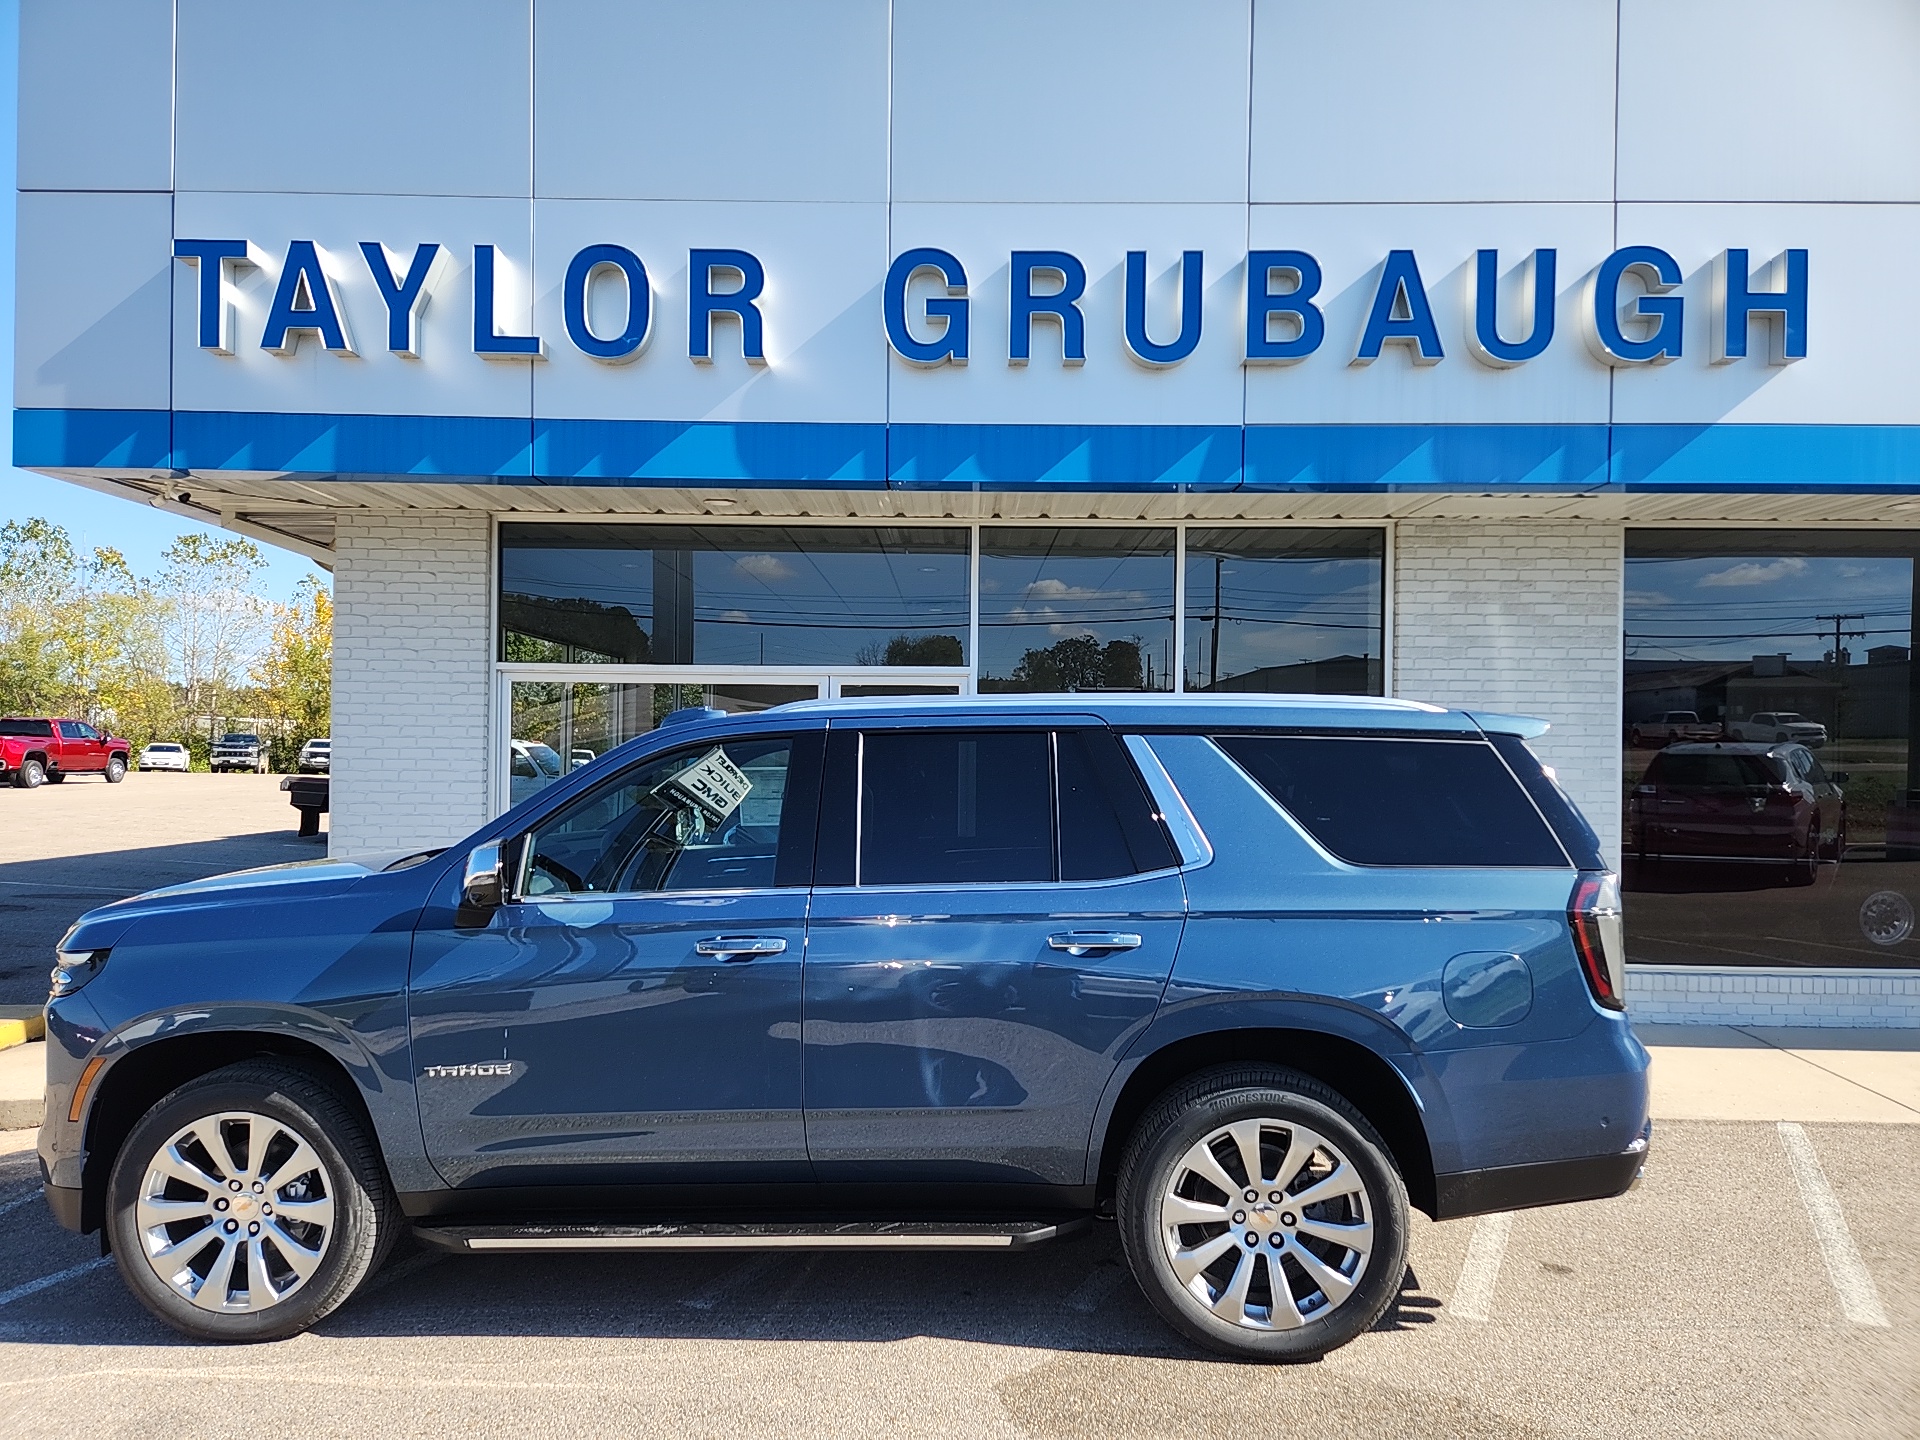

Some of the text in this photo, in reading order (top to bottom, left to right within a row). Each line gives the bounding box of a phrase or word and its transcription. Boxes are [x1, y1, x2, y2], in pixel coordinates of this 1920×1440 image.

[172, 239, 1808, 369] TAYLOR GRUBAUGH
[423, 1062, 513, 1078] TAHOE
[1208, 1092, 1289, 1112] BRIDGESTONE
